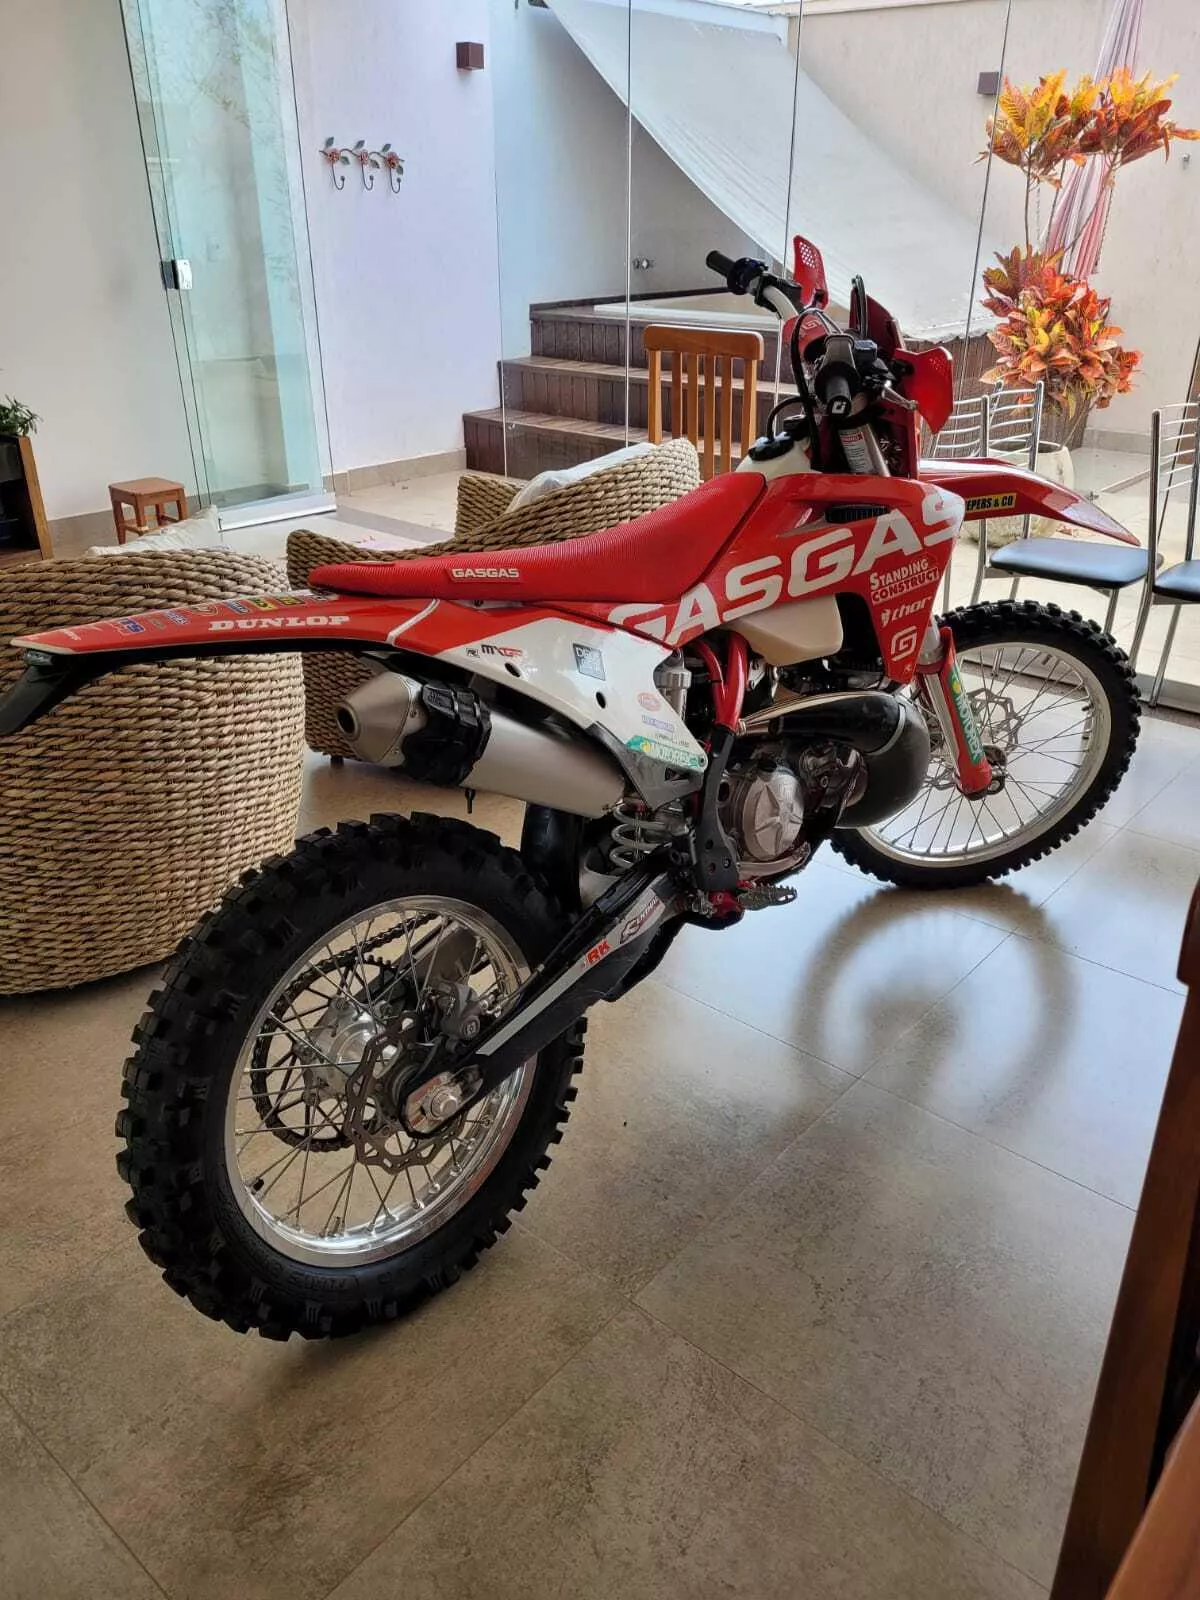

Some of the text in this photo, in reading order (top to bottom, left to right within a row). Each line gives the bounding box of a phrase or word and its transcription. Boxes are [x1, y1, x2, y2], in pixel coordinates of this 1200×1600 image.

[1002, 495, 1013, 506] CO
[451, 568, 520, 578] GASGAS
[608, 484, 966, 647] GASGAS
[869, 558, 929, 590] STANDING
[871, 568, 939, 604] CONSTRUCT
[208, 615, 350, 631] DUNLOP
